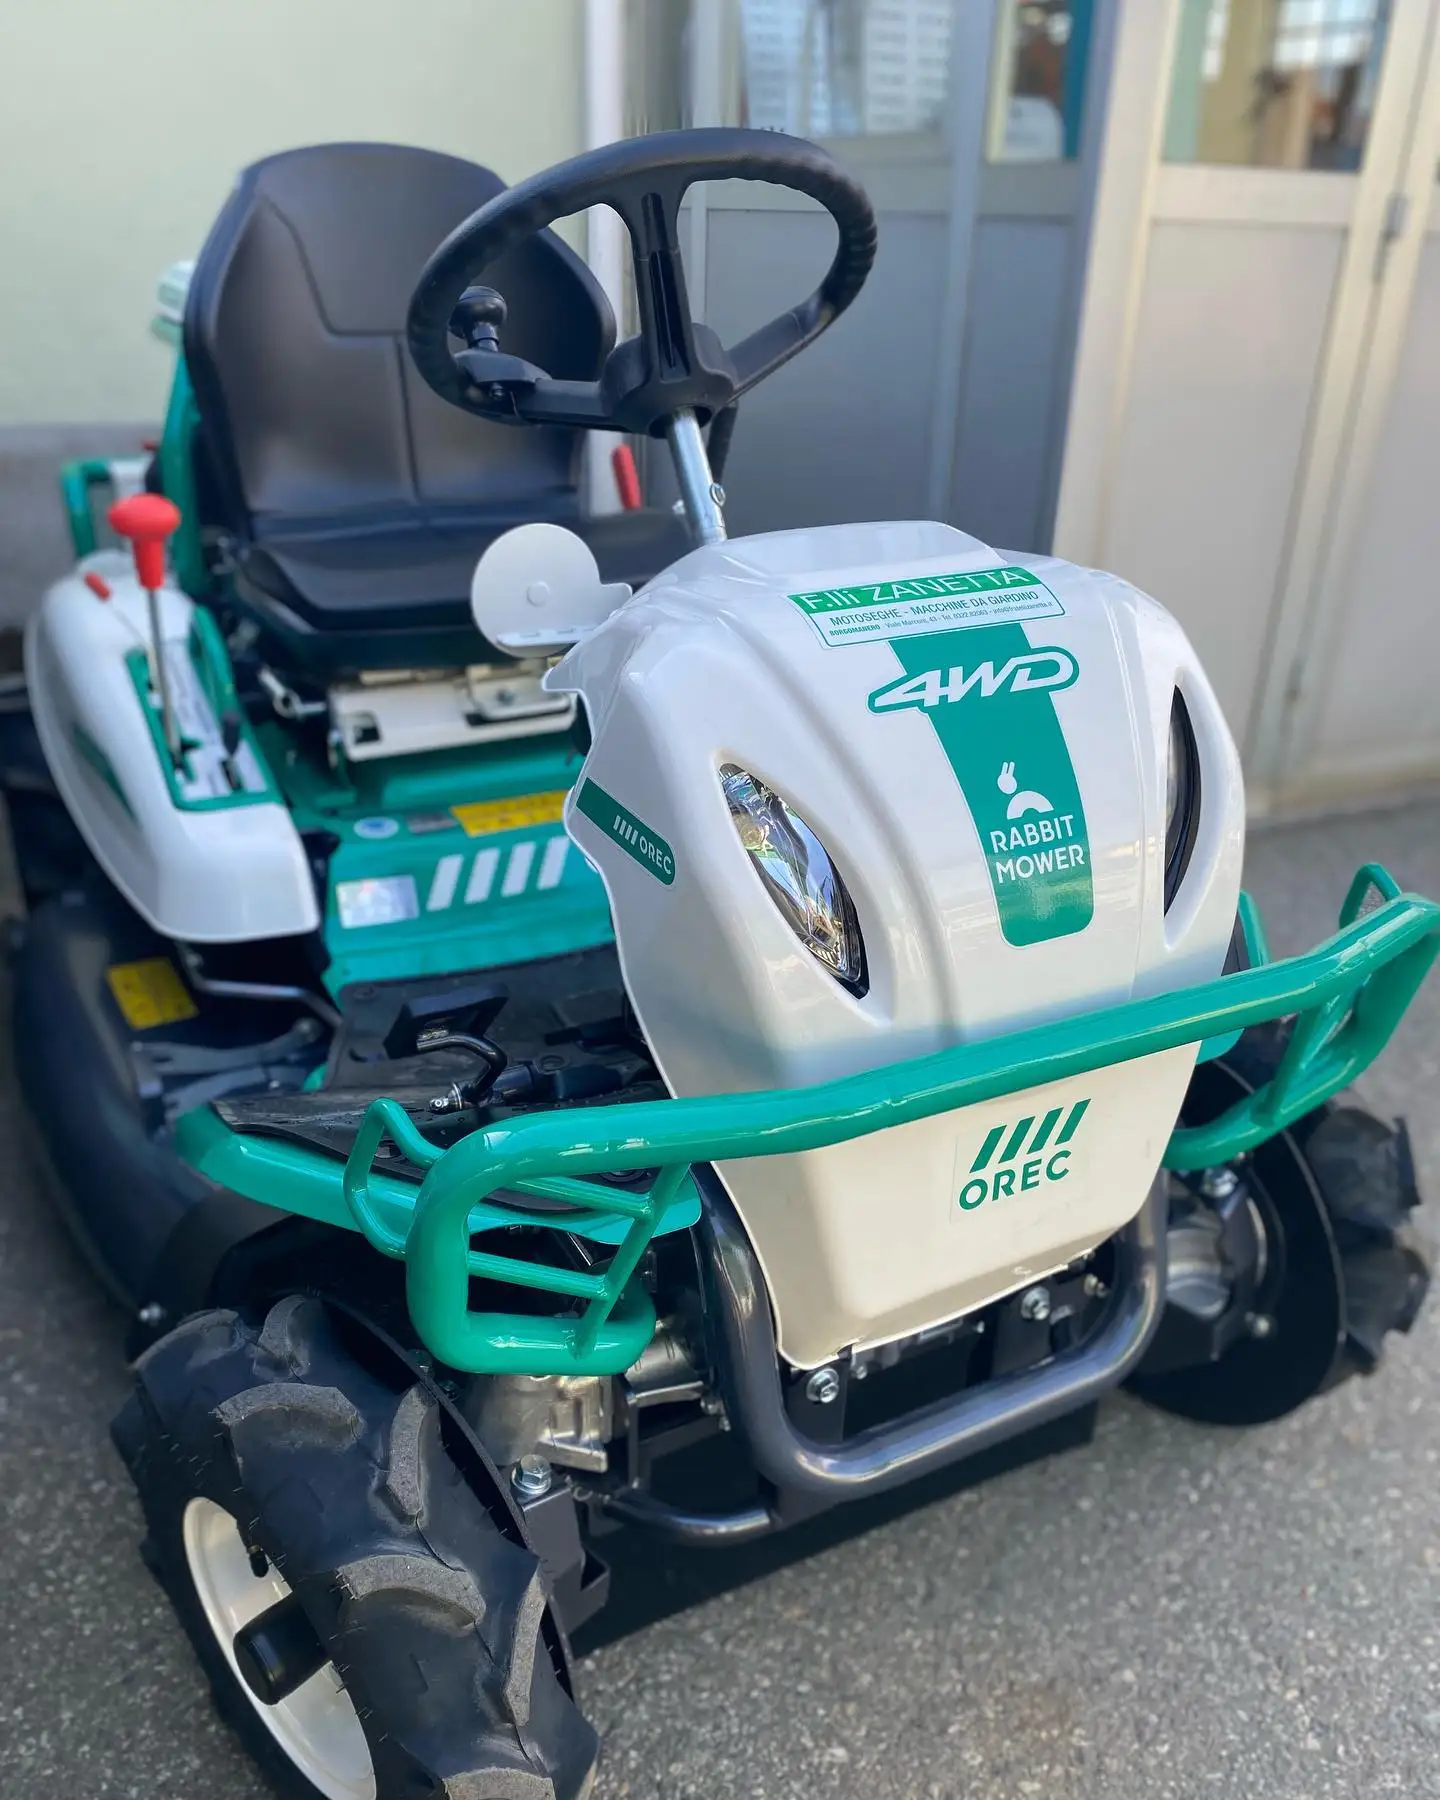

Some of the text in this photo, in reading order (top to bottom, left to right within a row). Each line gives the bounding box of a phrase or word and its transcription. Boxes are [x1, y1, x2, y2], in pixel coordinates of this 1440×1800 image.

[800, 570, 1029, 610] F.lli ZANETTA
[830, 609, 902, 627] MOTOSEGHE
[910, 600, 970, 616] MACCHINE
[972, 597, 988, 608] DA
[987, 591, 1039, 604] GIARDINO
[829, 624, 881, 636] BORGOMANERO
[886, 621, 902, 629] Viale
[874, 651, 1074, 708] 4WD
[990, 814, 1075, 854] RABBIT
[639, 835, 672, 875] OREC
[995, 844, 1085, 884] MOWER
[958, 1149, 1072, 1211] OREC
